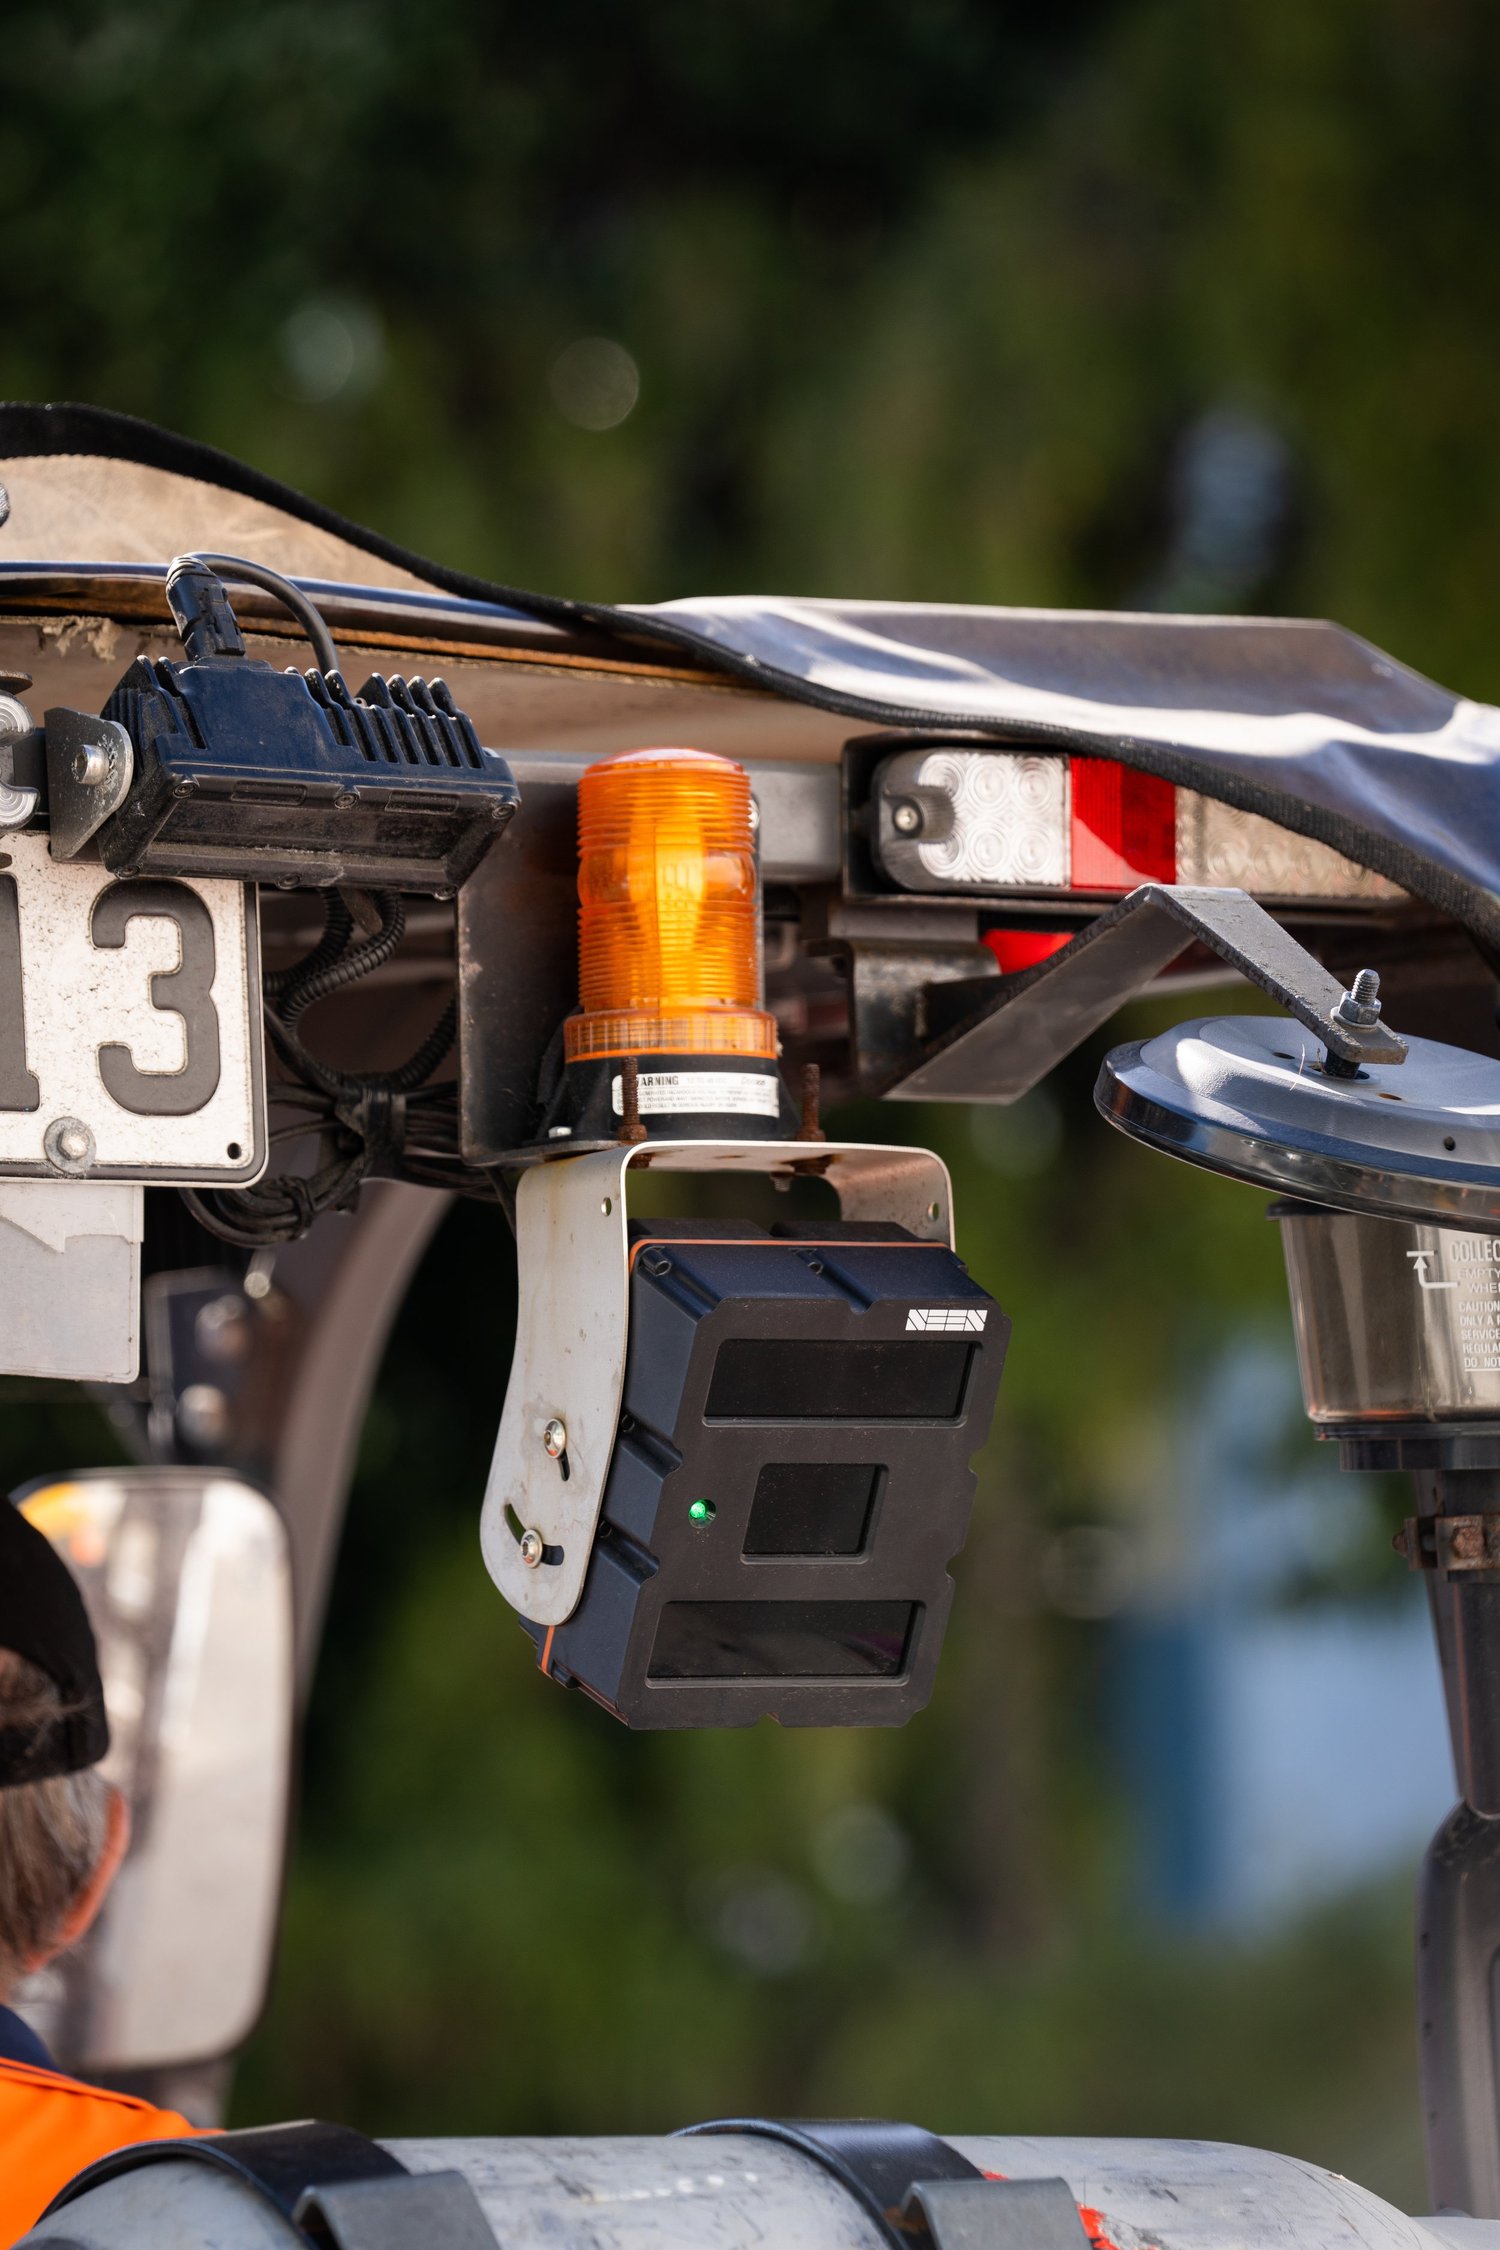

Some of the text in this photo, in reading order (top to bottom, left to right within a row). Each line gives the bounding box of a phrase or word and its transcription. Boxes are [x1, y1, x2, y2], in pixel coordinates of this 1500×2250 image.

[636, 1075, 679, 1087] ARNING
[1450, 1239, 1500, 1262] COLLEC
[1457, 1268, 1500, 1278] EMPTY
[1460, 1315, 1484, 1327] ONLY
[1487, 1315, 1494, 1326] A
[1461, 1328, 1500, 1340] SERVICE
[1465, 1357, 1478, 1368] DO
